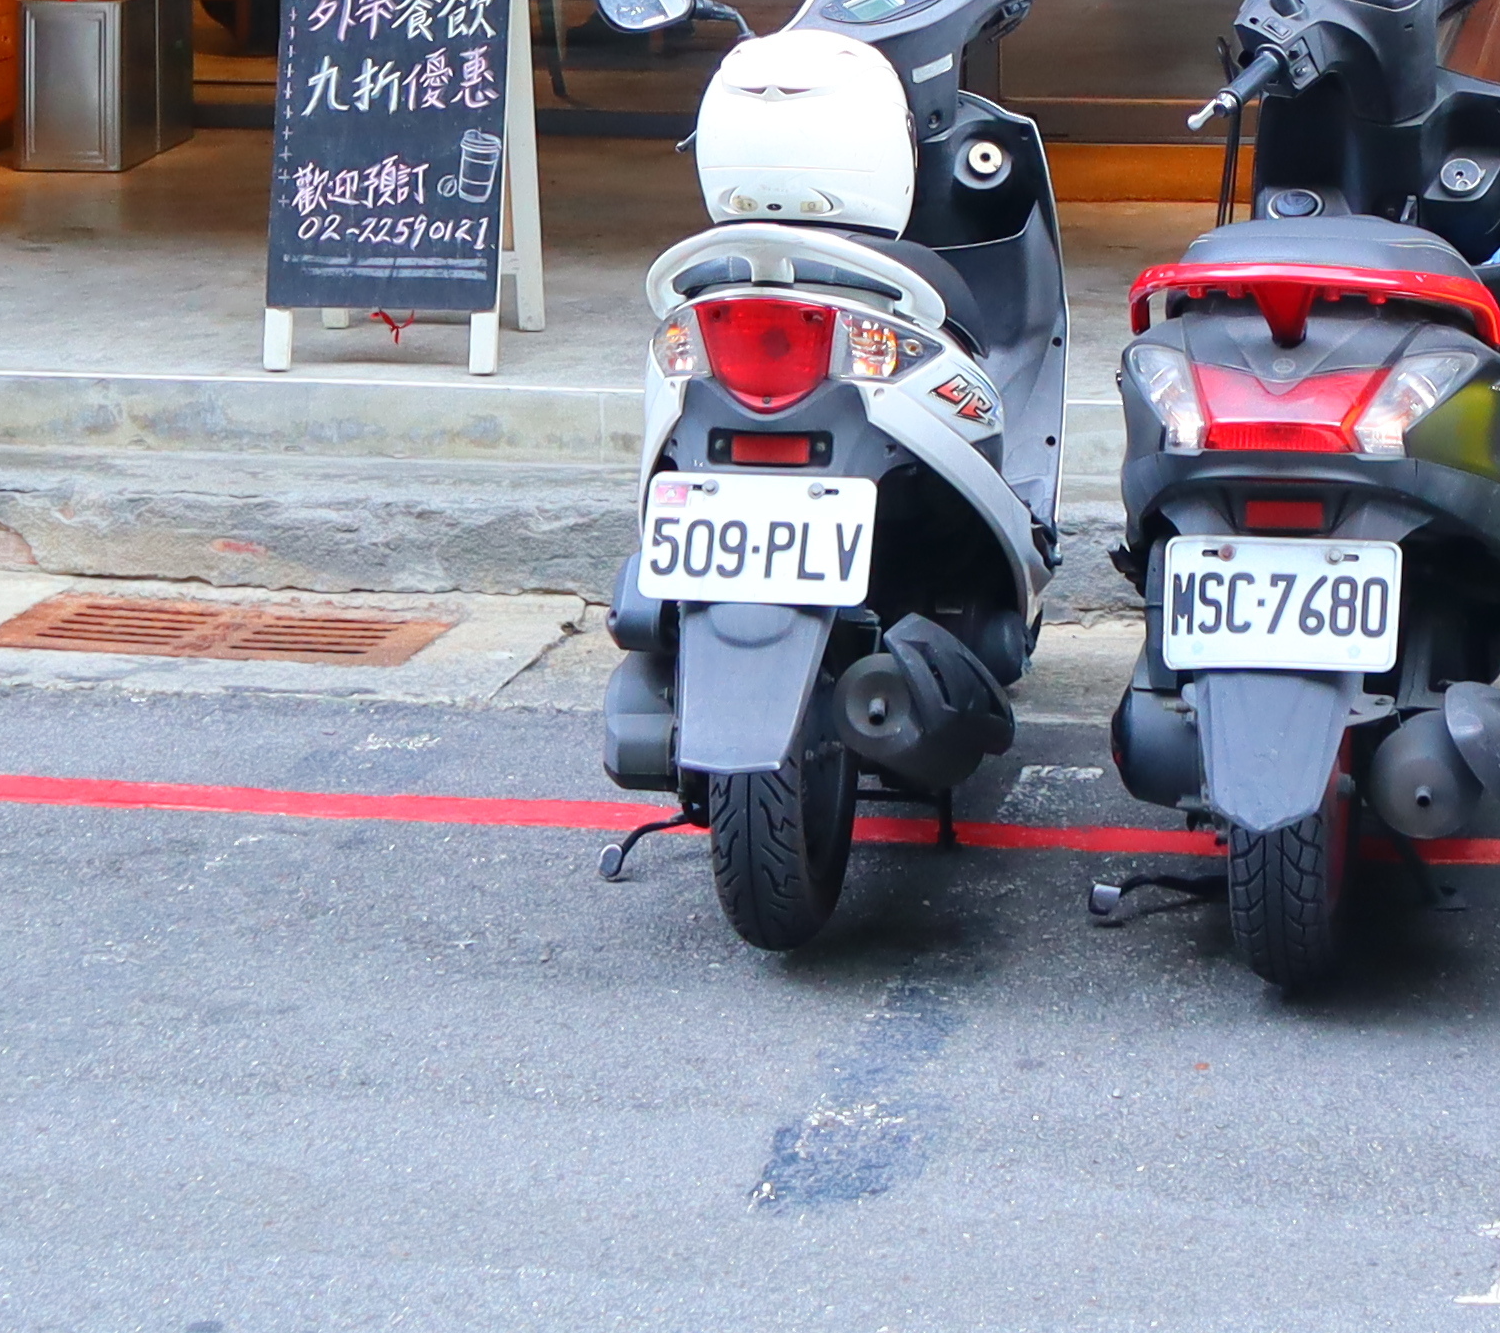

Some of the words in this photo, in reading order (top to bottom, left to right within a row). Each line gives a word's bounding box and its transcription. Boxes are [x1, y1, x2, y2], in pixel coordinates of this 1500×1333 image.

[301, 46, 500, 116] 九折優惠
[291, 155, 429, 215] 歡迎預訂
